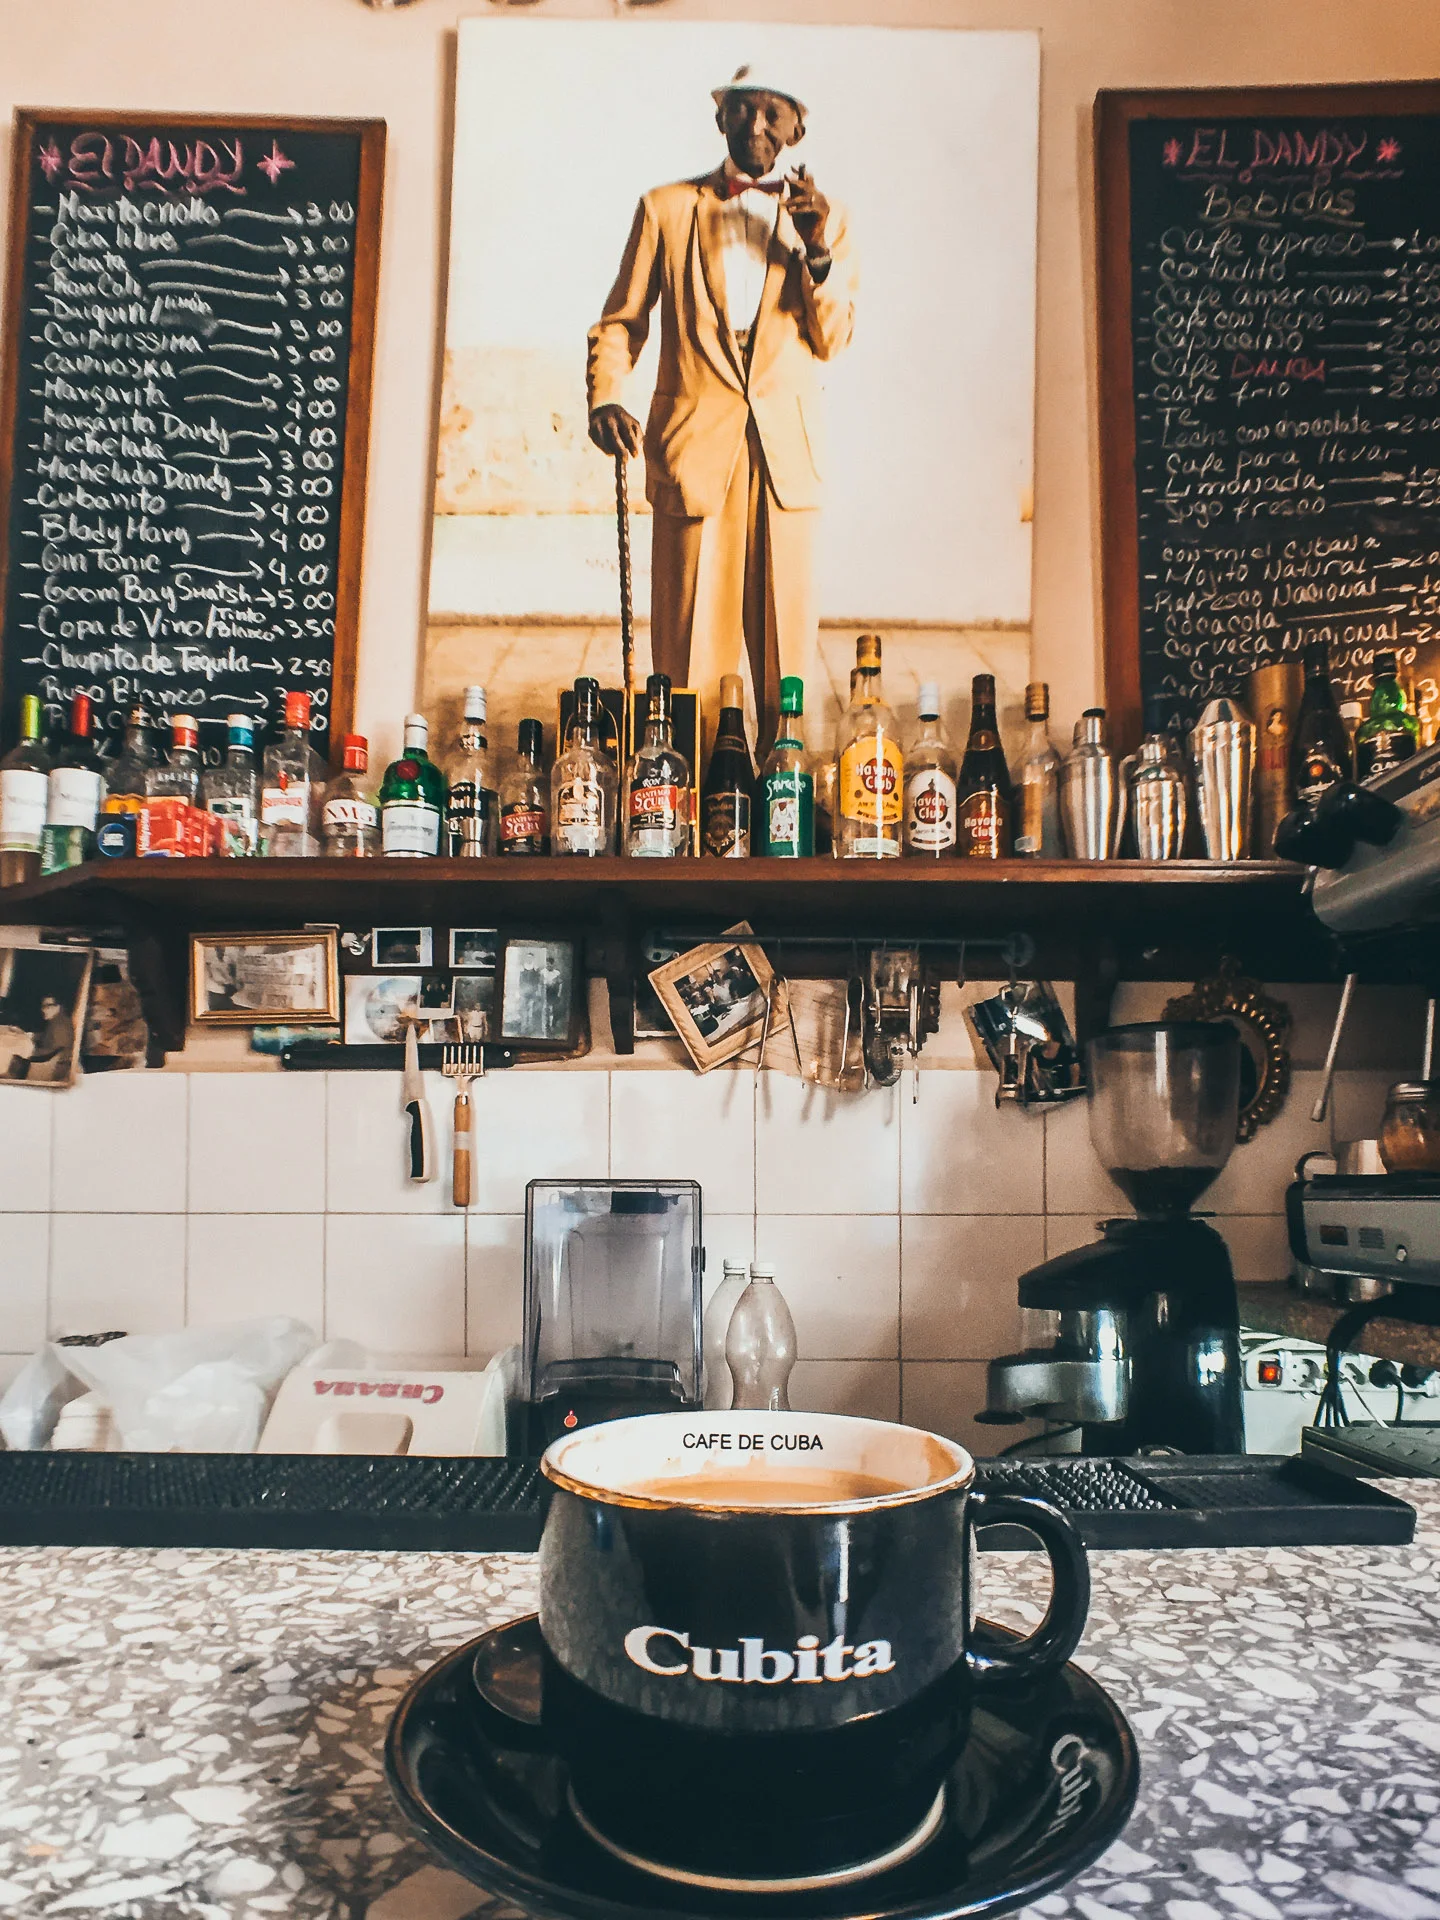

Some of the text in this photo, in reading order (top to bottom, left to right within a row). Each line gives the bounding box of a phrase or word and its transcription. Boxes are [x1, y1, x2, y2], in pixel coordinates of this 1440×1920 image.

[1250, 128, 1368, 168] DANDY
[682, 1432, 824, 1451] CAFE DE CUBA
[624, 1624, 896, 1685] Cubita
